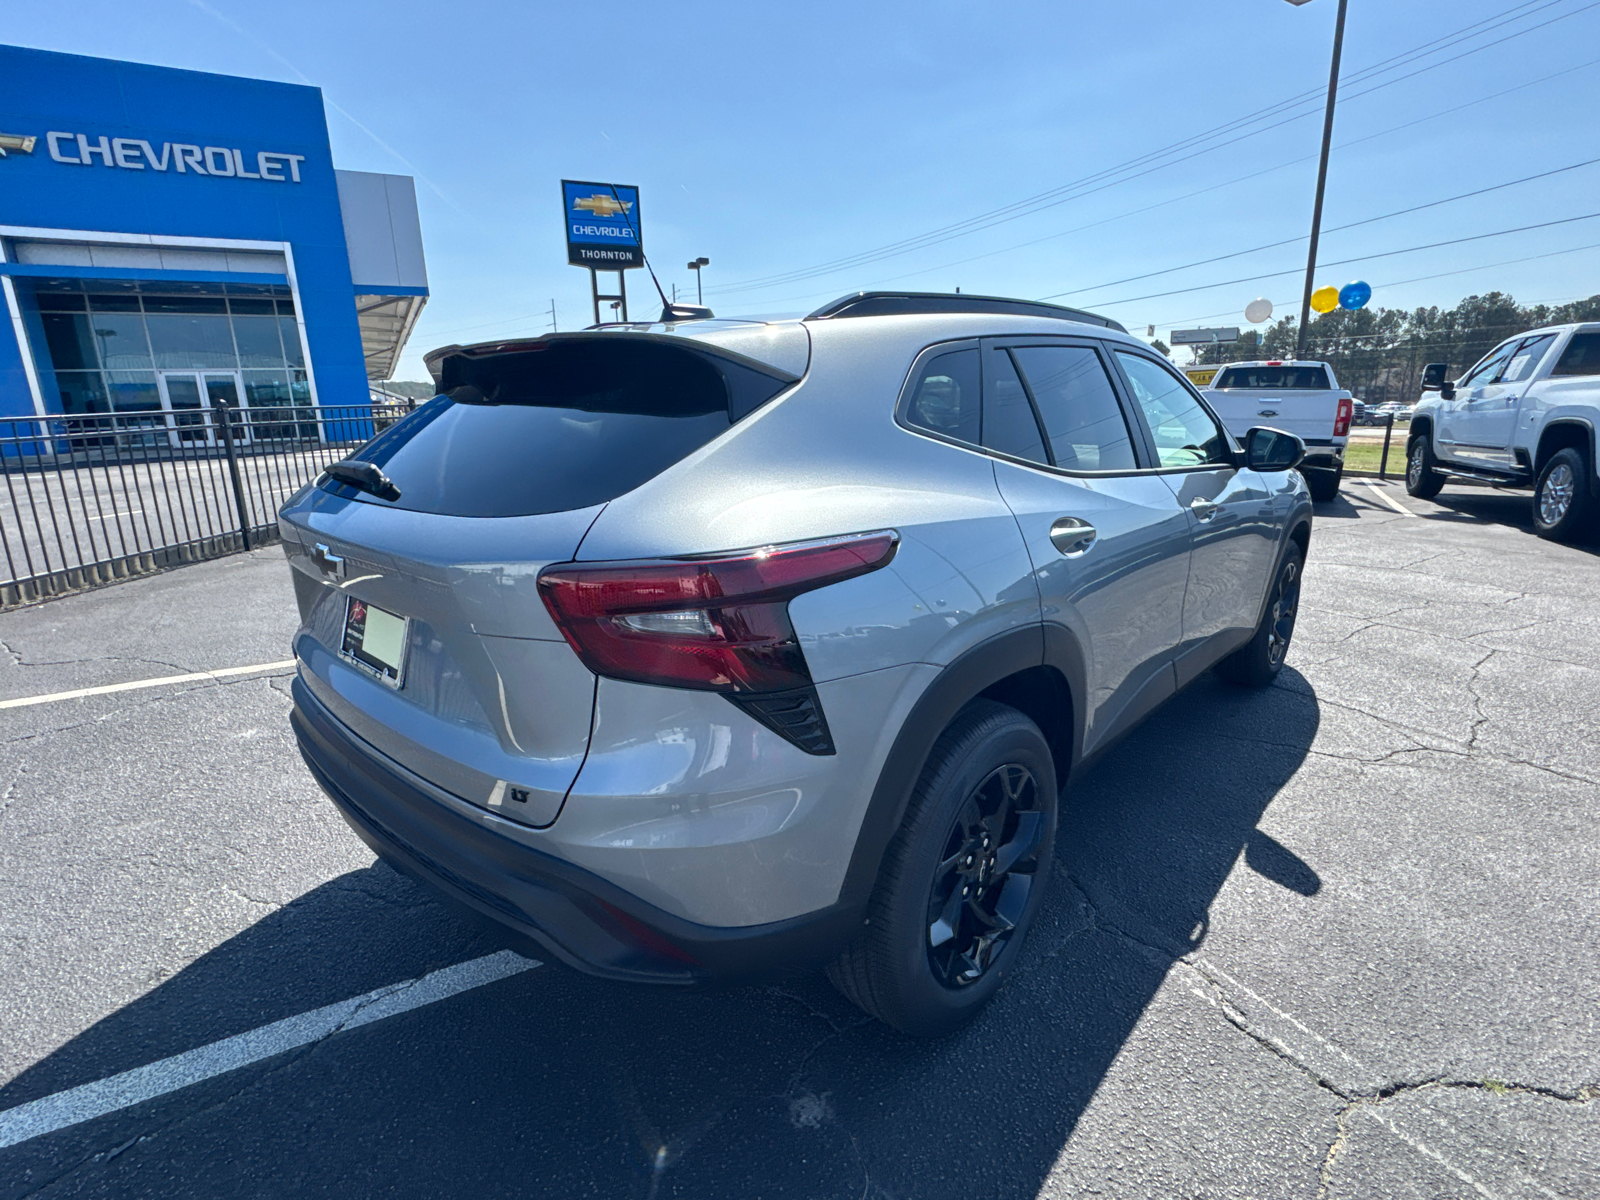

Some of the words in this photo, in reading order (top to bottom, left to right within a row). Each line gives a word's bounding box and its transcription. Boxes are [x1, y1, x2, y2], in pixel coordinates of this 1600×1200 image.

[46, 131, 305, 182] CHEVROLET
[573, 225, 635, 237] CHEVROLET
[580, 249, 633, 260] THORNTON
[511, 788, 529, 803] LT
